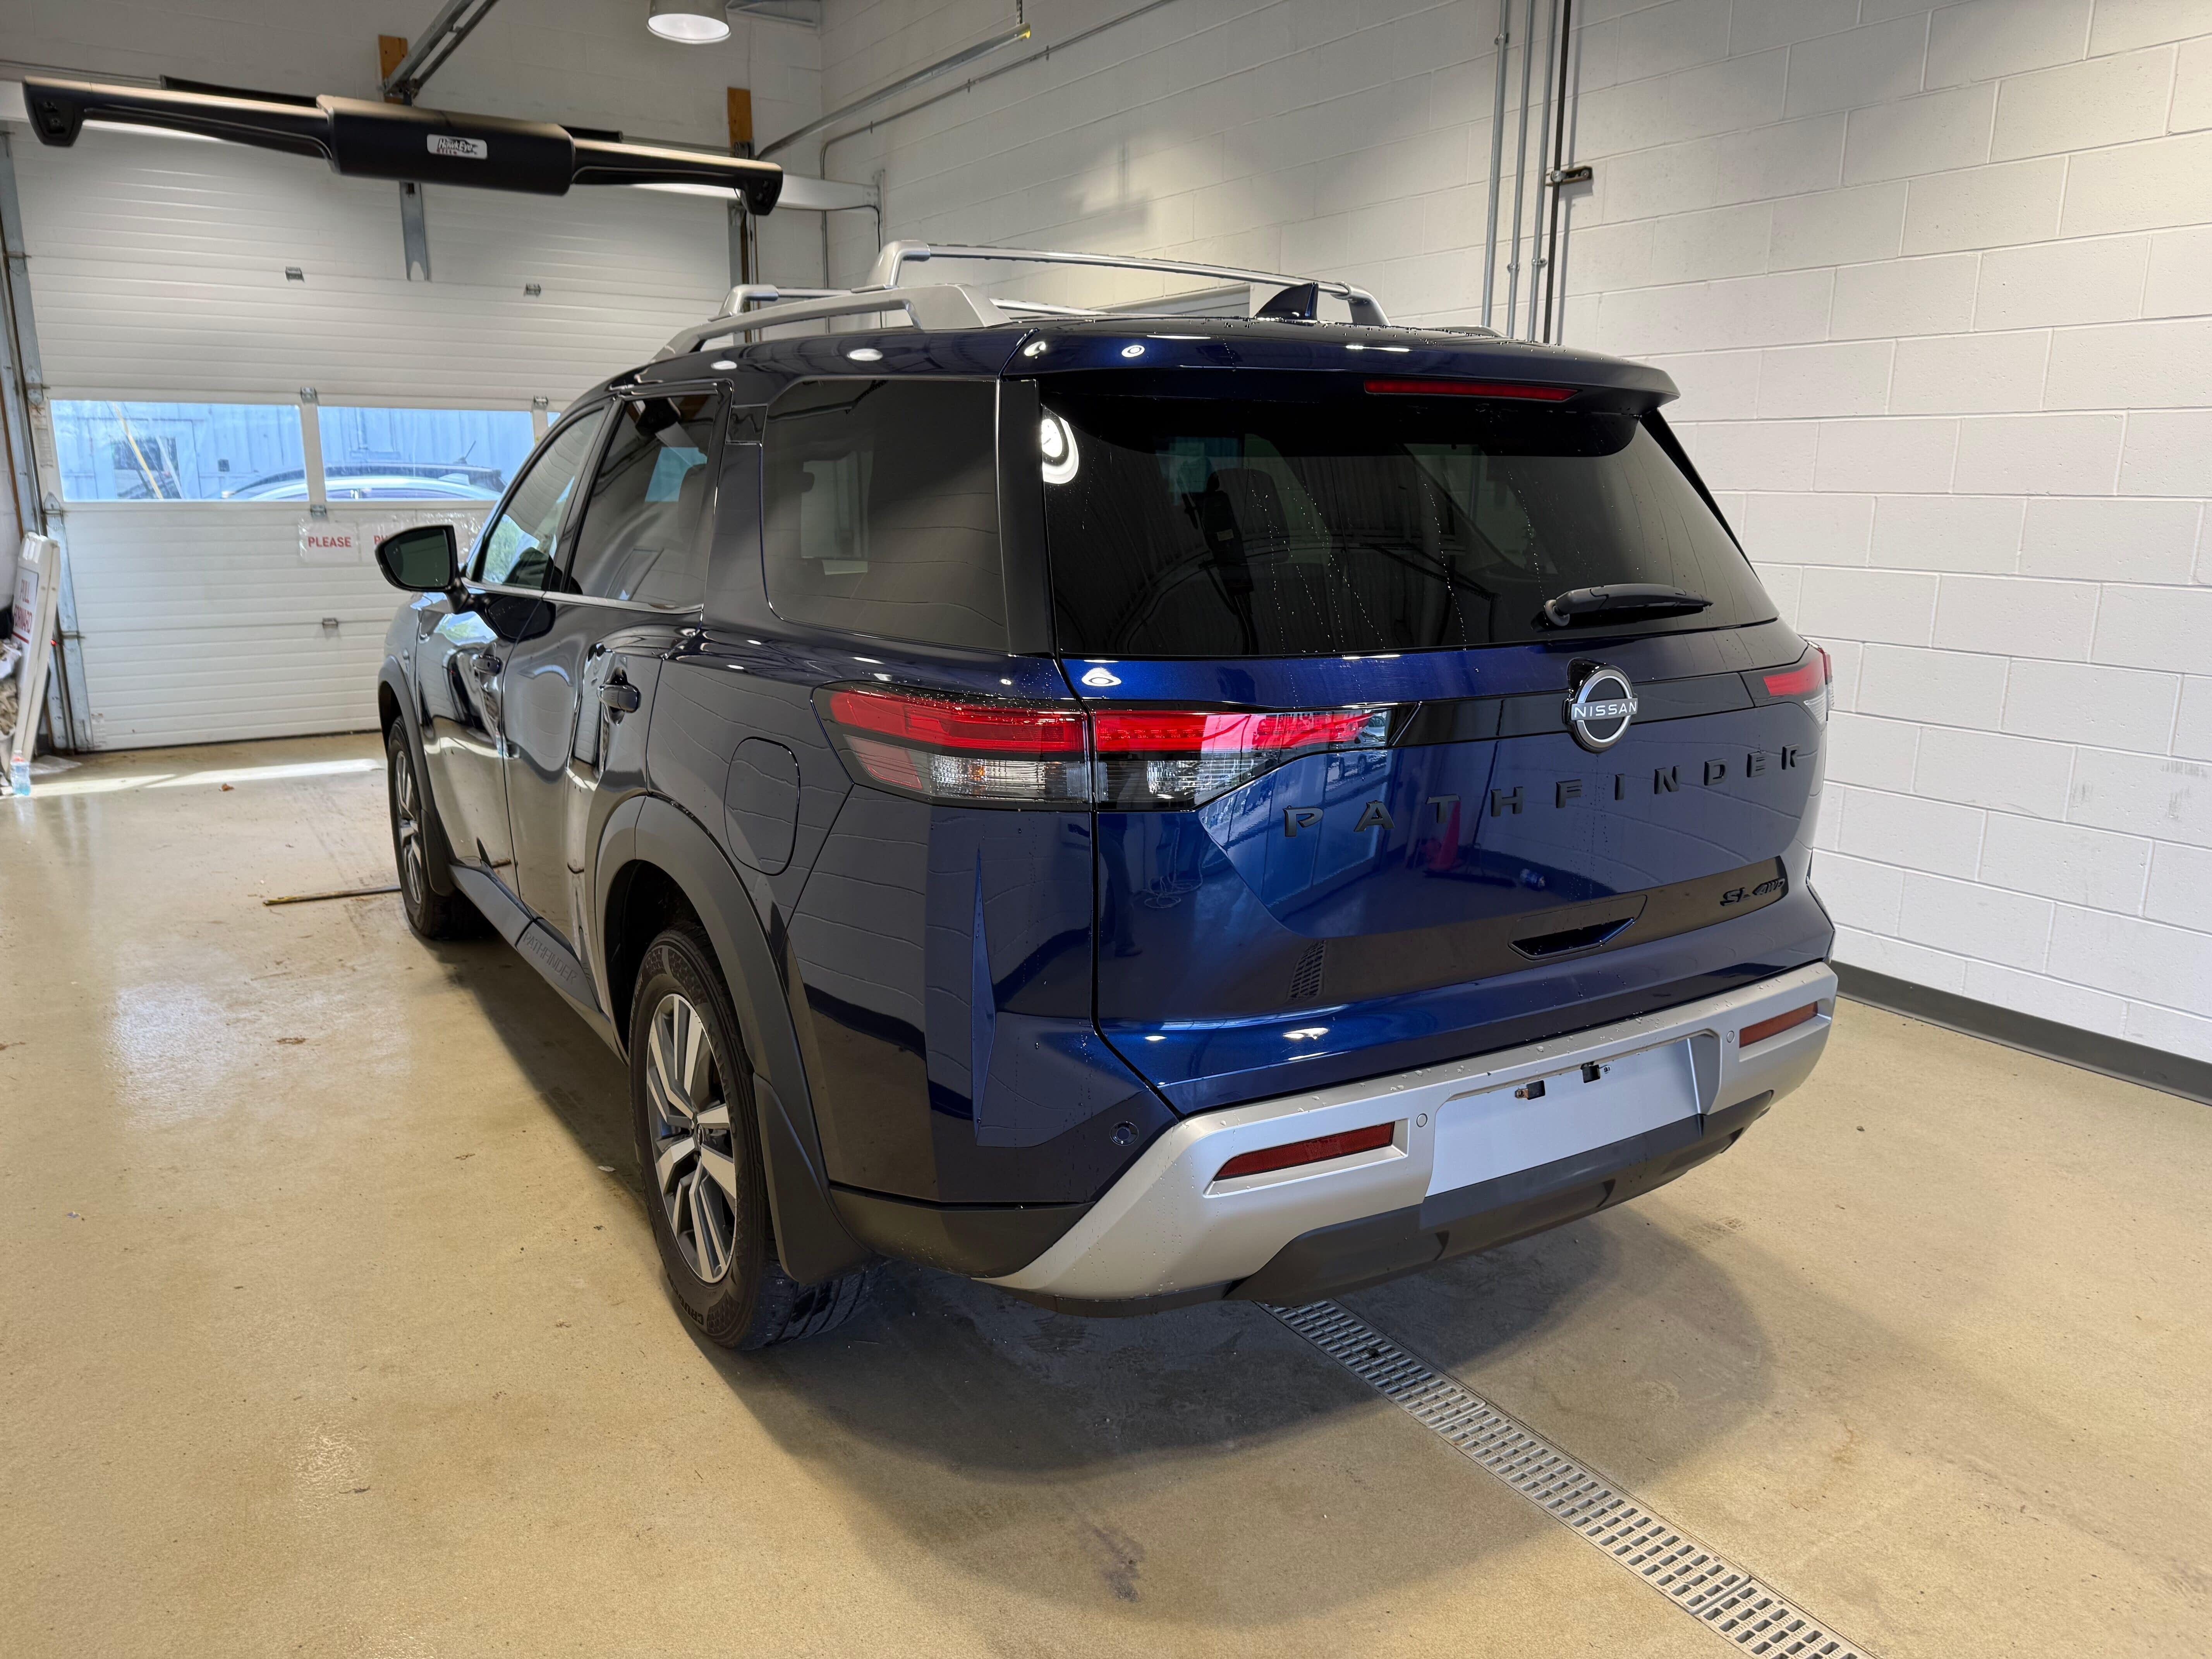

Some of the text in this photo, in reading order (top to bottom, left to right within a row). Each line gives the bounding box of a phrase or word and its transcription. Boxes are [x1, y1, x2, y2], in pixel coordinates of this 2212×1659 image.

[308, 536, 352, 547] PLEASE
[20, 579, 29, 604] PULL
[14, 604, 32, 634] FORWARD
[1574, 701, 1637, 718] NISSAN
[1283, 743, 1800, 837] PATHFINDER
[1720, 887, 1751, 906] SL
[522, 931, 578, 984] PATHFINDER
[708, 1021, 737, 1139] KUMHO
